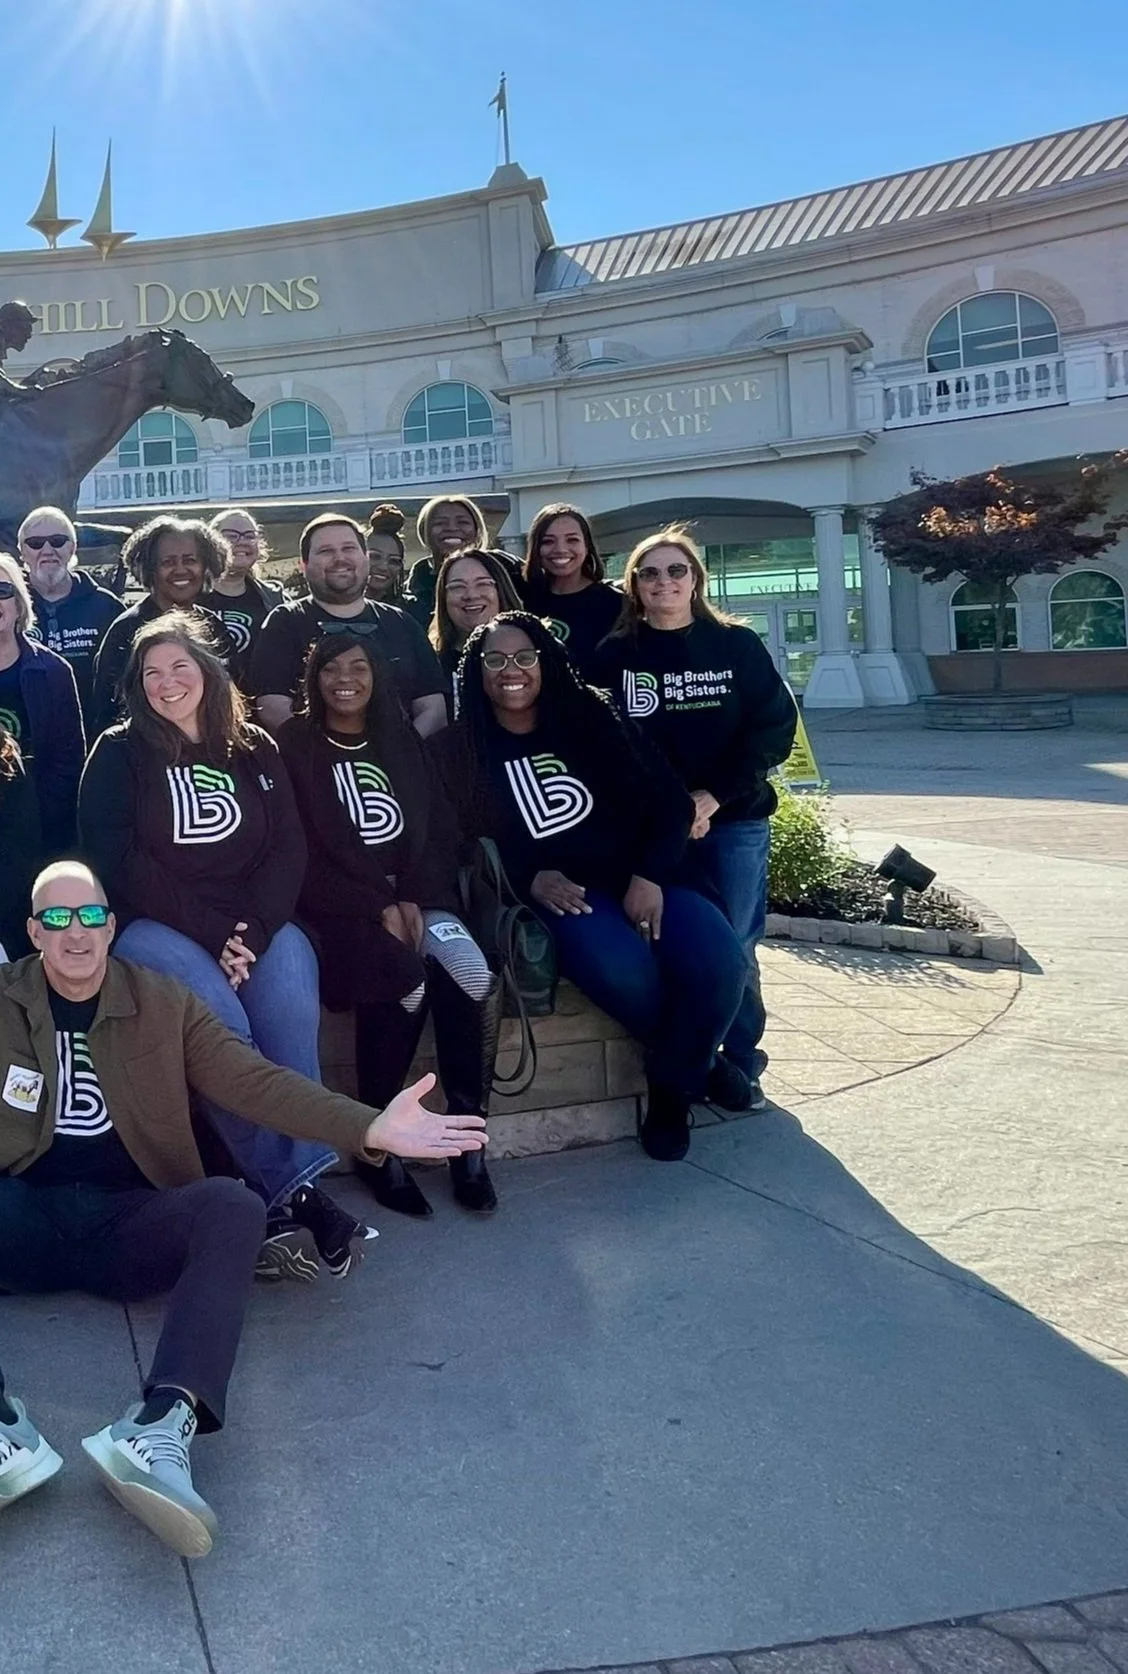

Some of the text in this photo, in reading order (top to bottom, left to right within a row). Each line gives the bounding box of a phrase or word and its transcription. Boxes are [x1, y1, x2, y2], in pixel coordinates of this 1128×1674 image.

[133, 275, 320, 327] DOWNS
[584, 379, 762, 422] EXECUTIVE
[630, 412, 713, 441] GATE
[62, 627, 98, 639] Brothers
[664, 670, 733, 686] Big Brothers
[664, 685, 732, 701] Big Sisters.
